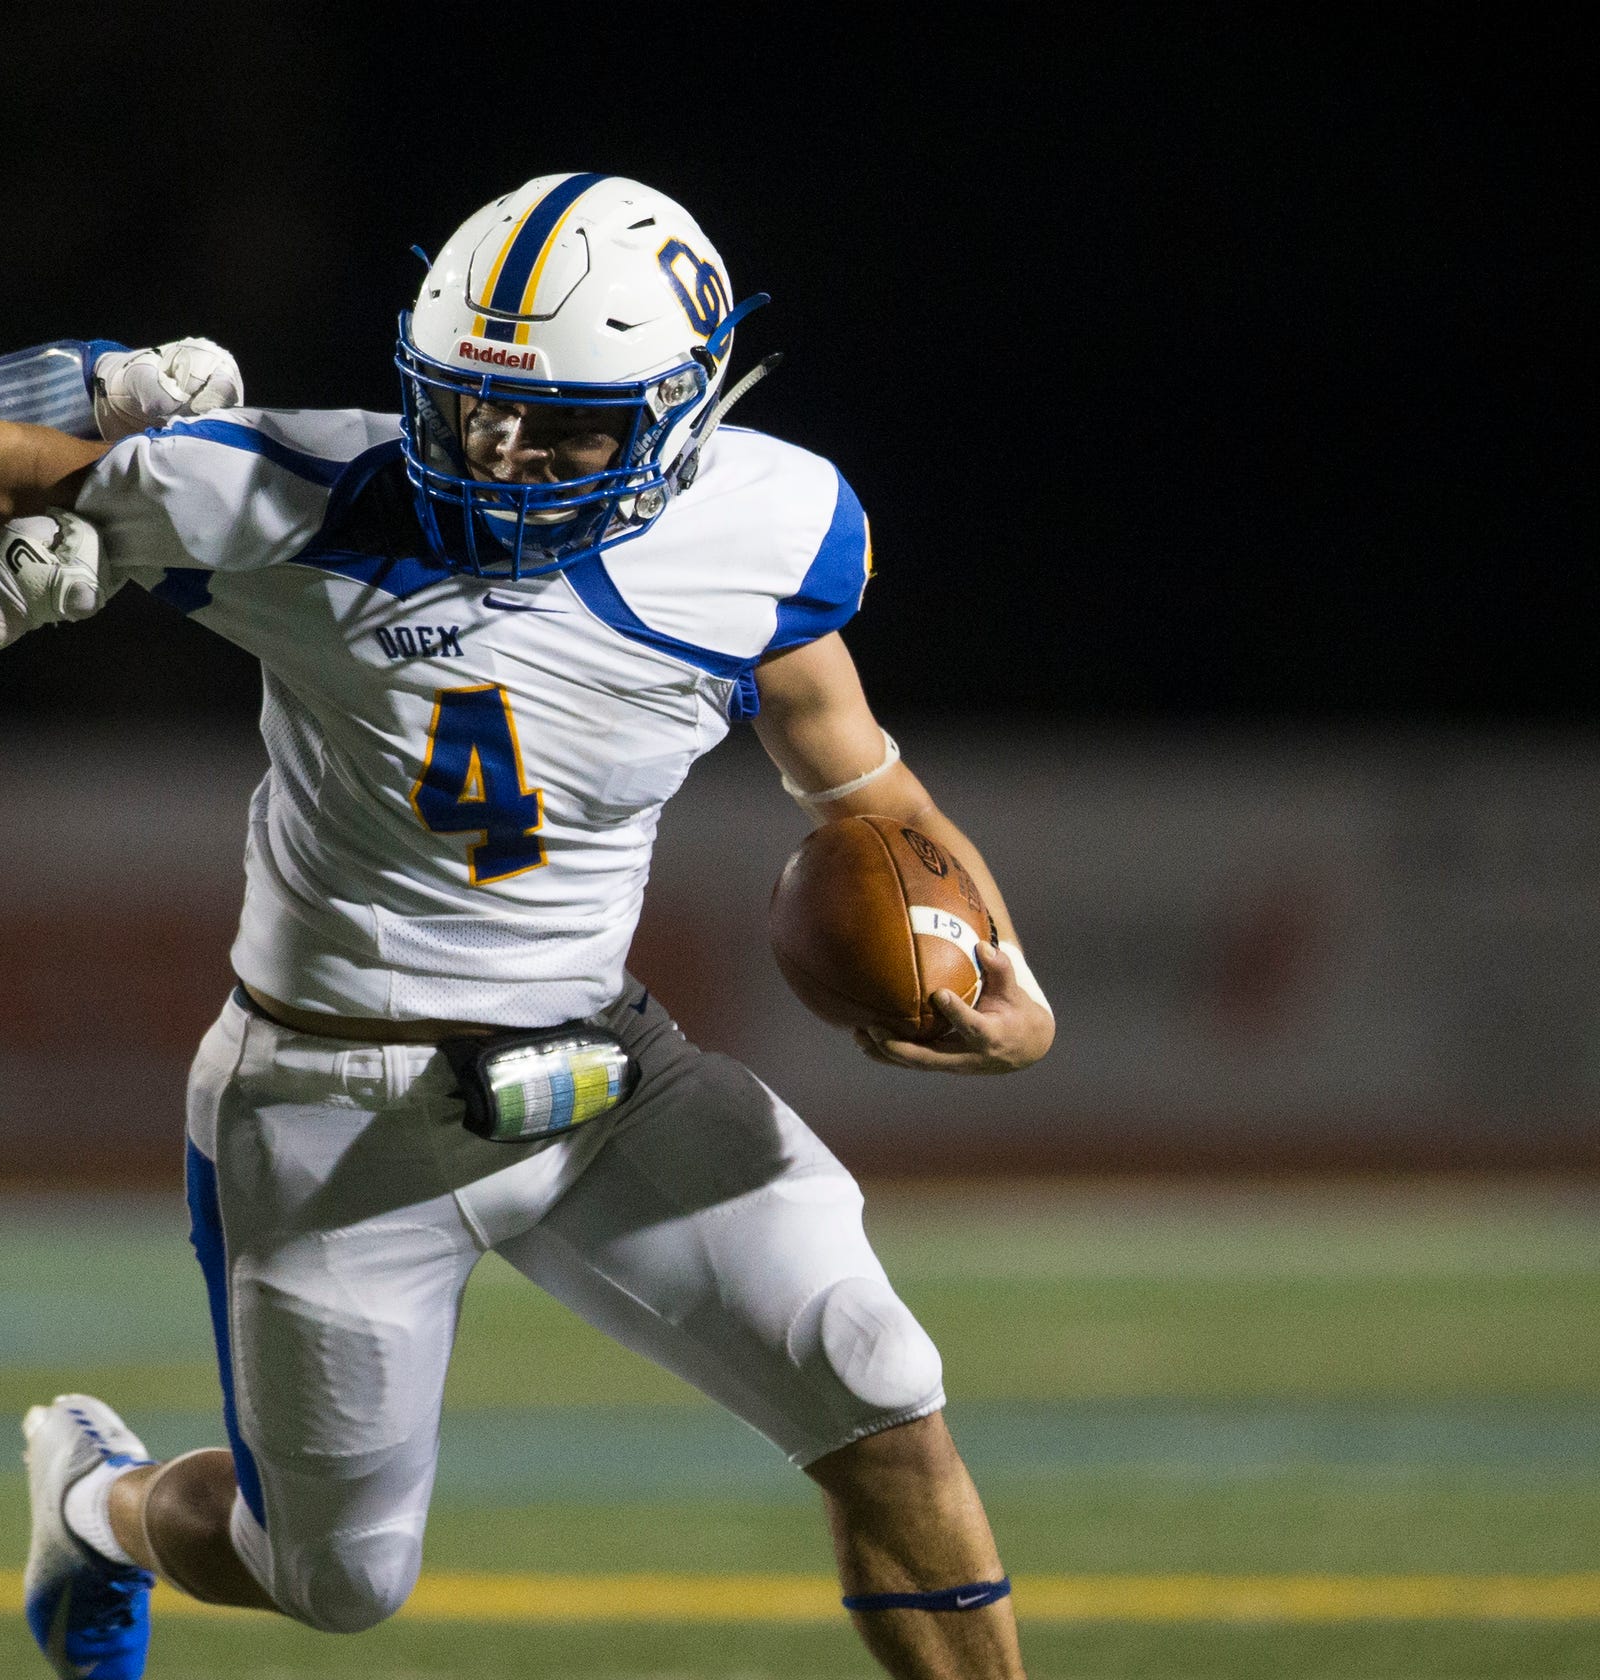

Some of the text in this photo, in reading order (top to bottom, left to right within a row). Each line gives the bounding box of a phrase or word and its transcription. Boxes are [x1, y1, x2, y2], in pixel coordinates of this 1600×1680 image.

[459, 341, 536, 371] Riddell
[376, 625, 464, 658] ODEM
[409, 683, 548, 886] 4
